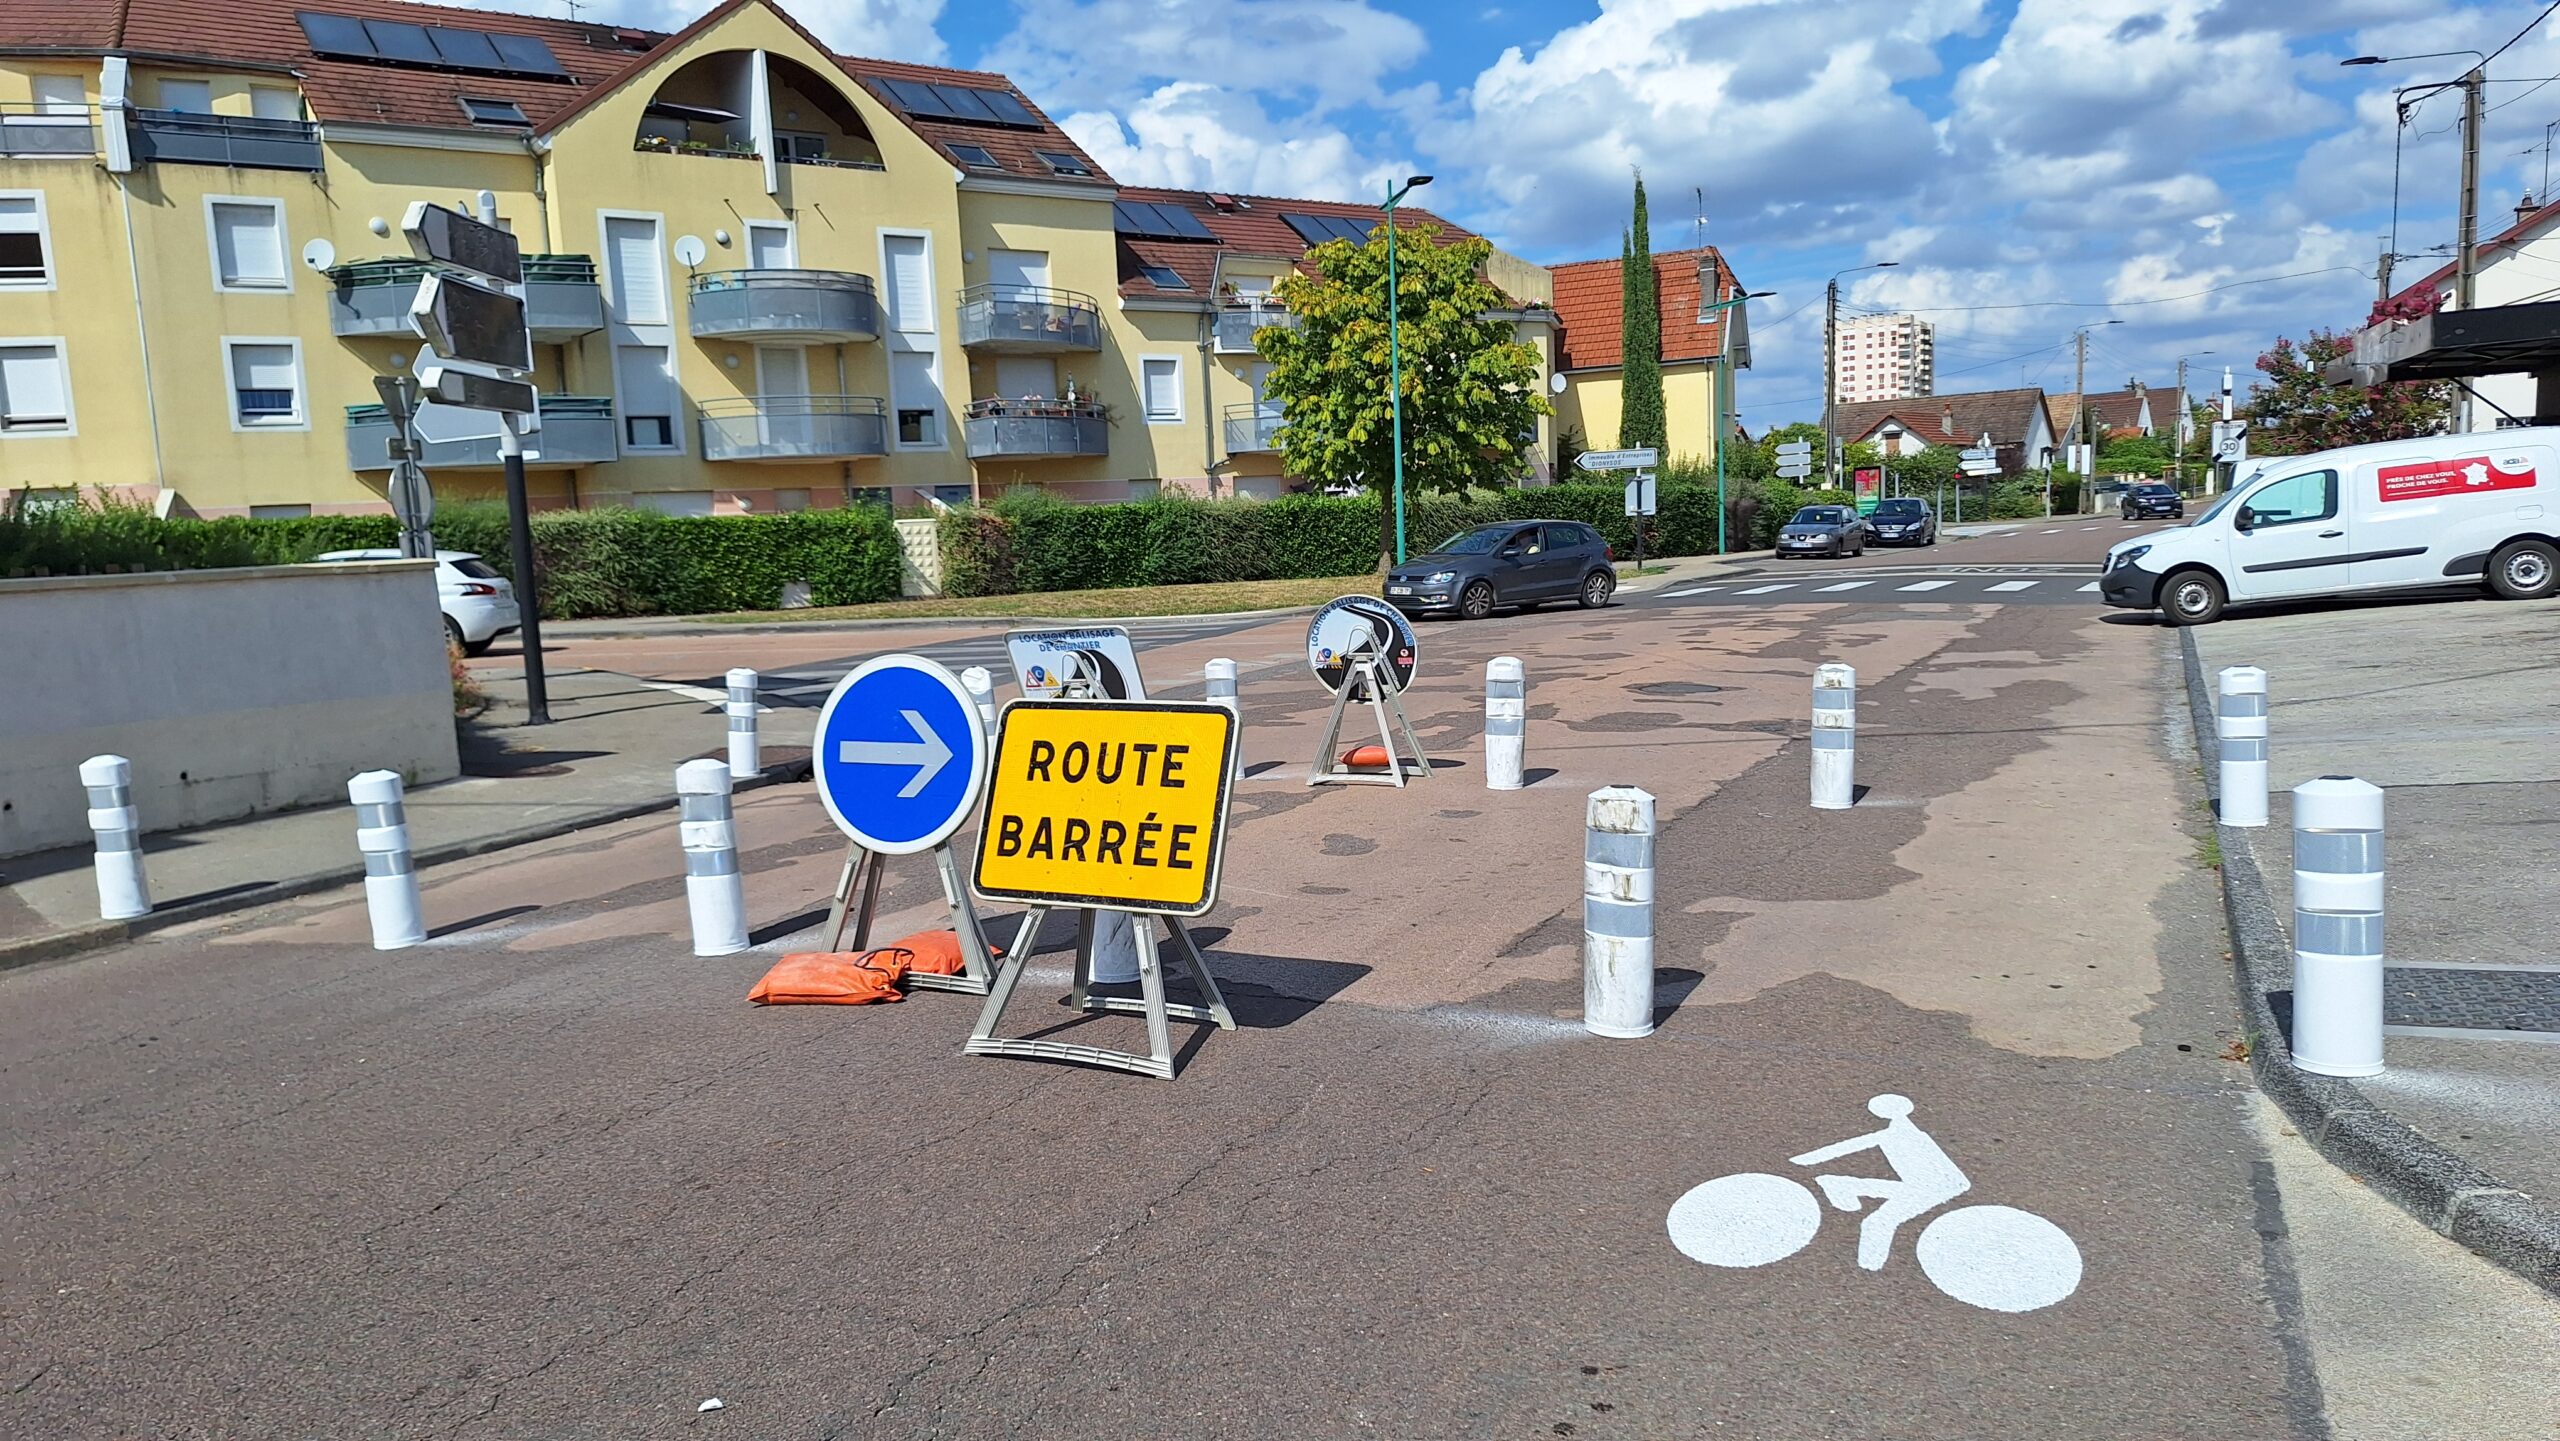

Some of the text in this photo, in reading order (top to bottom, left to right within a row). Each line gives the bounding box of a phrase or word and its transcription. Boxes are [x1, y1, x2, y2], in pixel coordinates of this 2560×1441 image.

[2223, 442, 2236, 450] 30
[1018, 630, 1116, 643] LOCATION BALISAGE
[1312, 597, 1414, 647] LOCATION BALISAGE DE CHANTIER
[1039, 641, 1102, 652] DE CHANTIER
[1026, 740, 1190, 788] ROUTE
[996, 812, 1198, 870] BARRÉE
